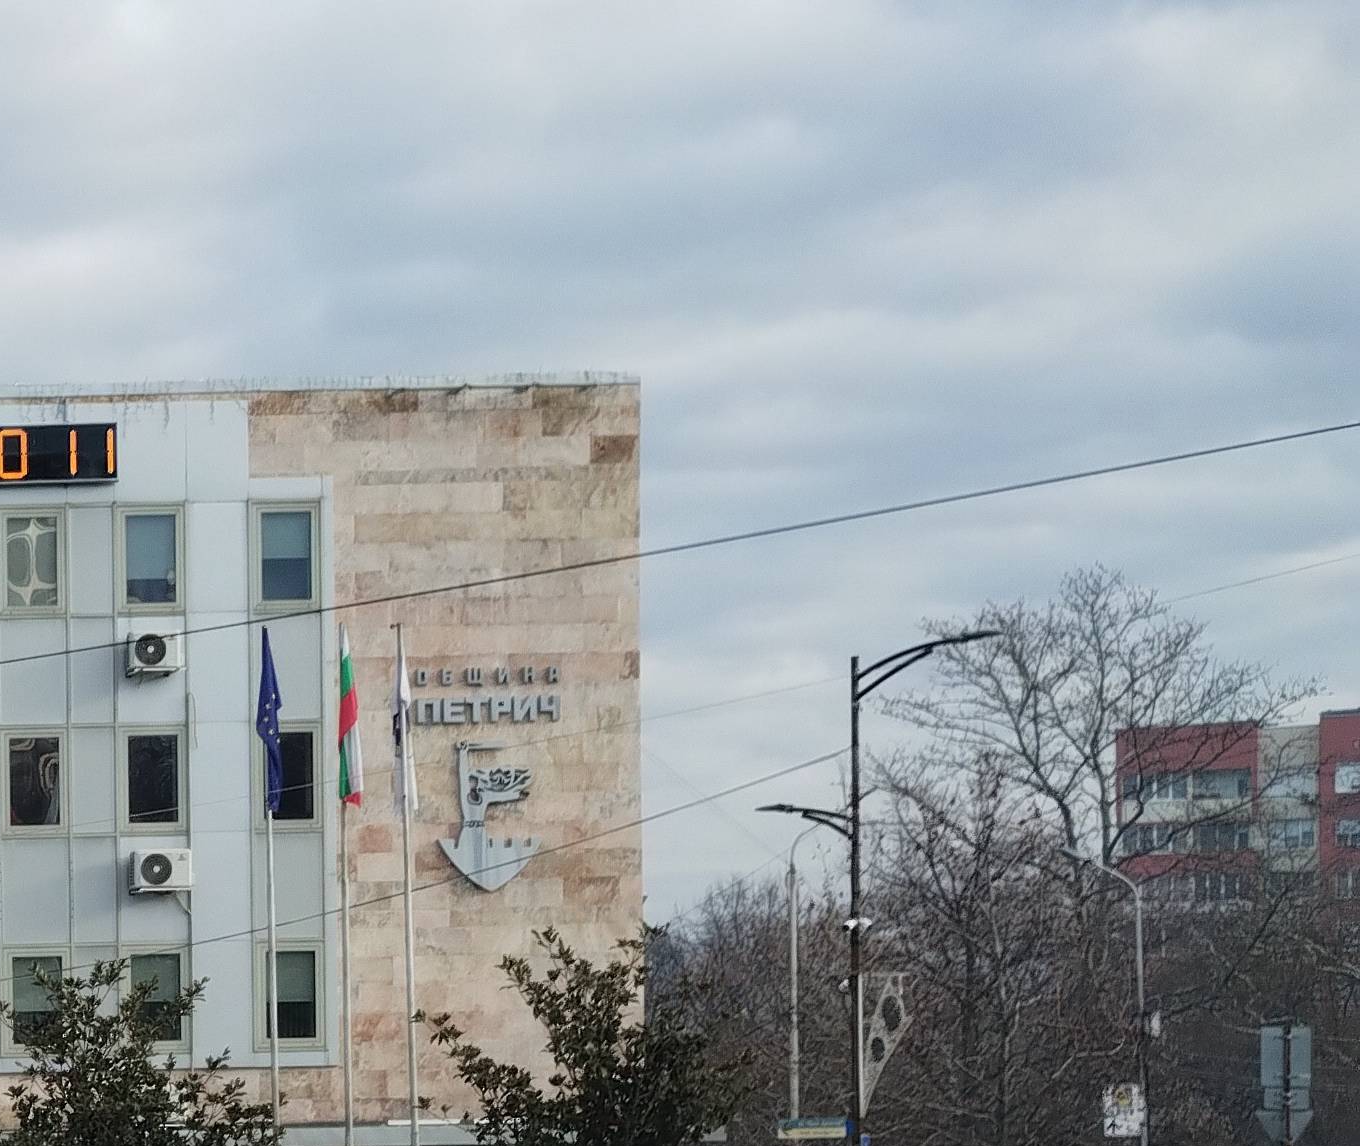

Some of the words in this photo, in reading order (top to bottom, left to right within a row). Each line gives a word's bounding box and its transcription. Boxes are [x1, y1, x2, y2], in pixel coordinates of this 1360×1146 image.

[69, 428, 115, 477] 11
[416, 665, 561, 687] ОБЩИНА
[415, 695, 561, 724] ПЕТРИЧ
